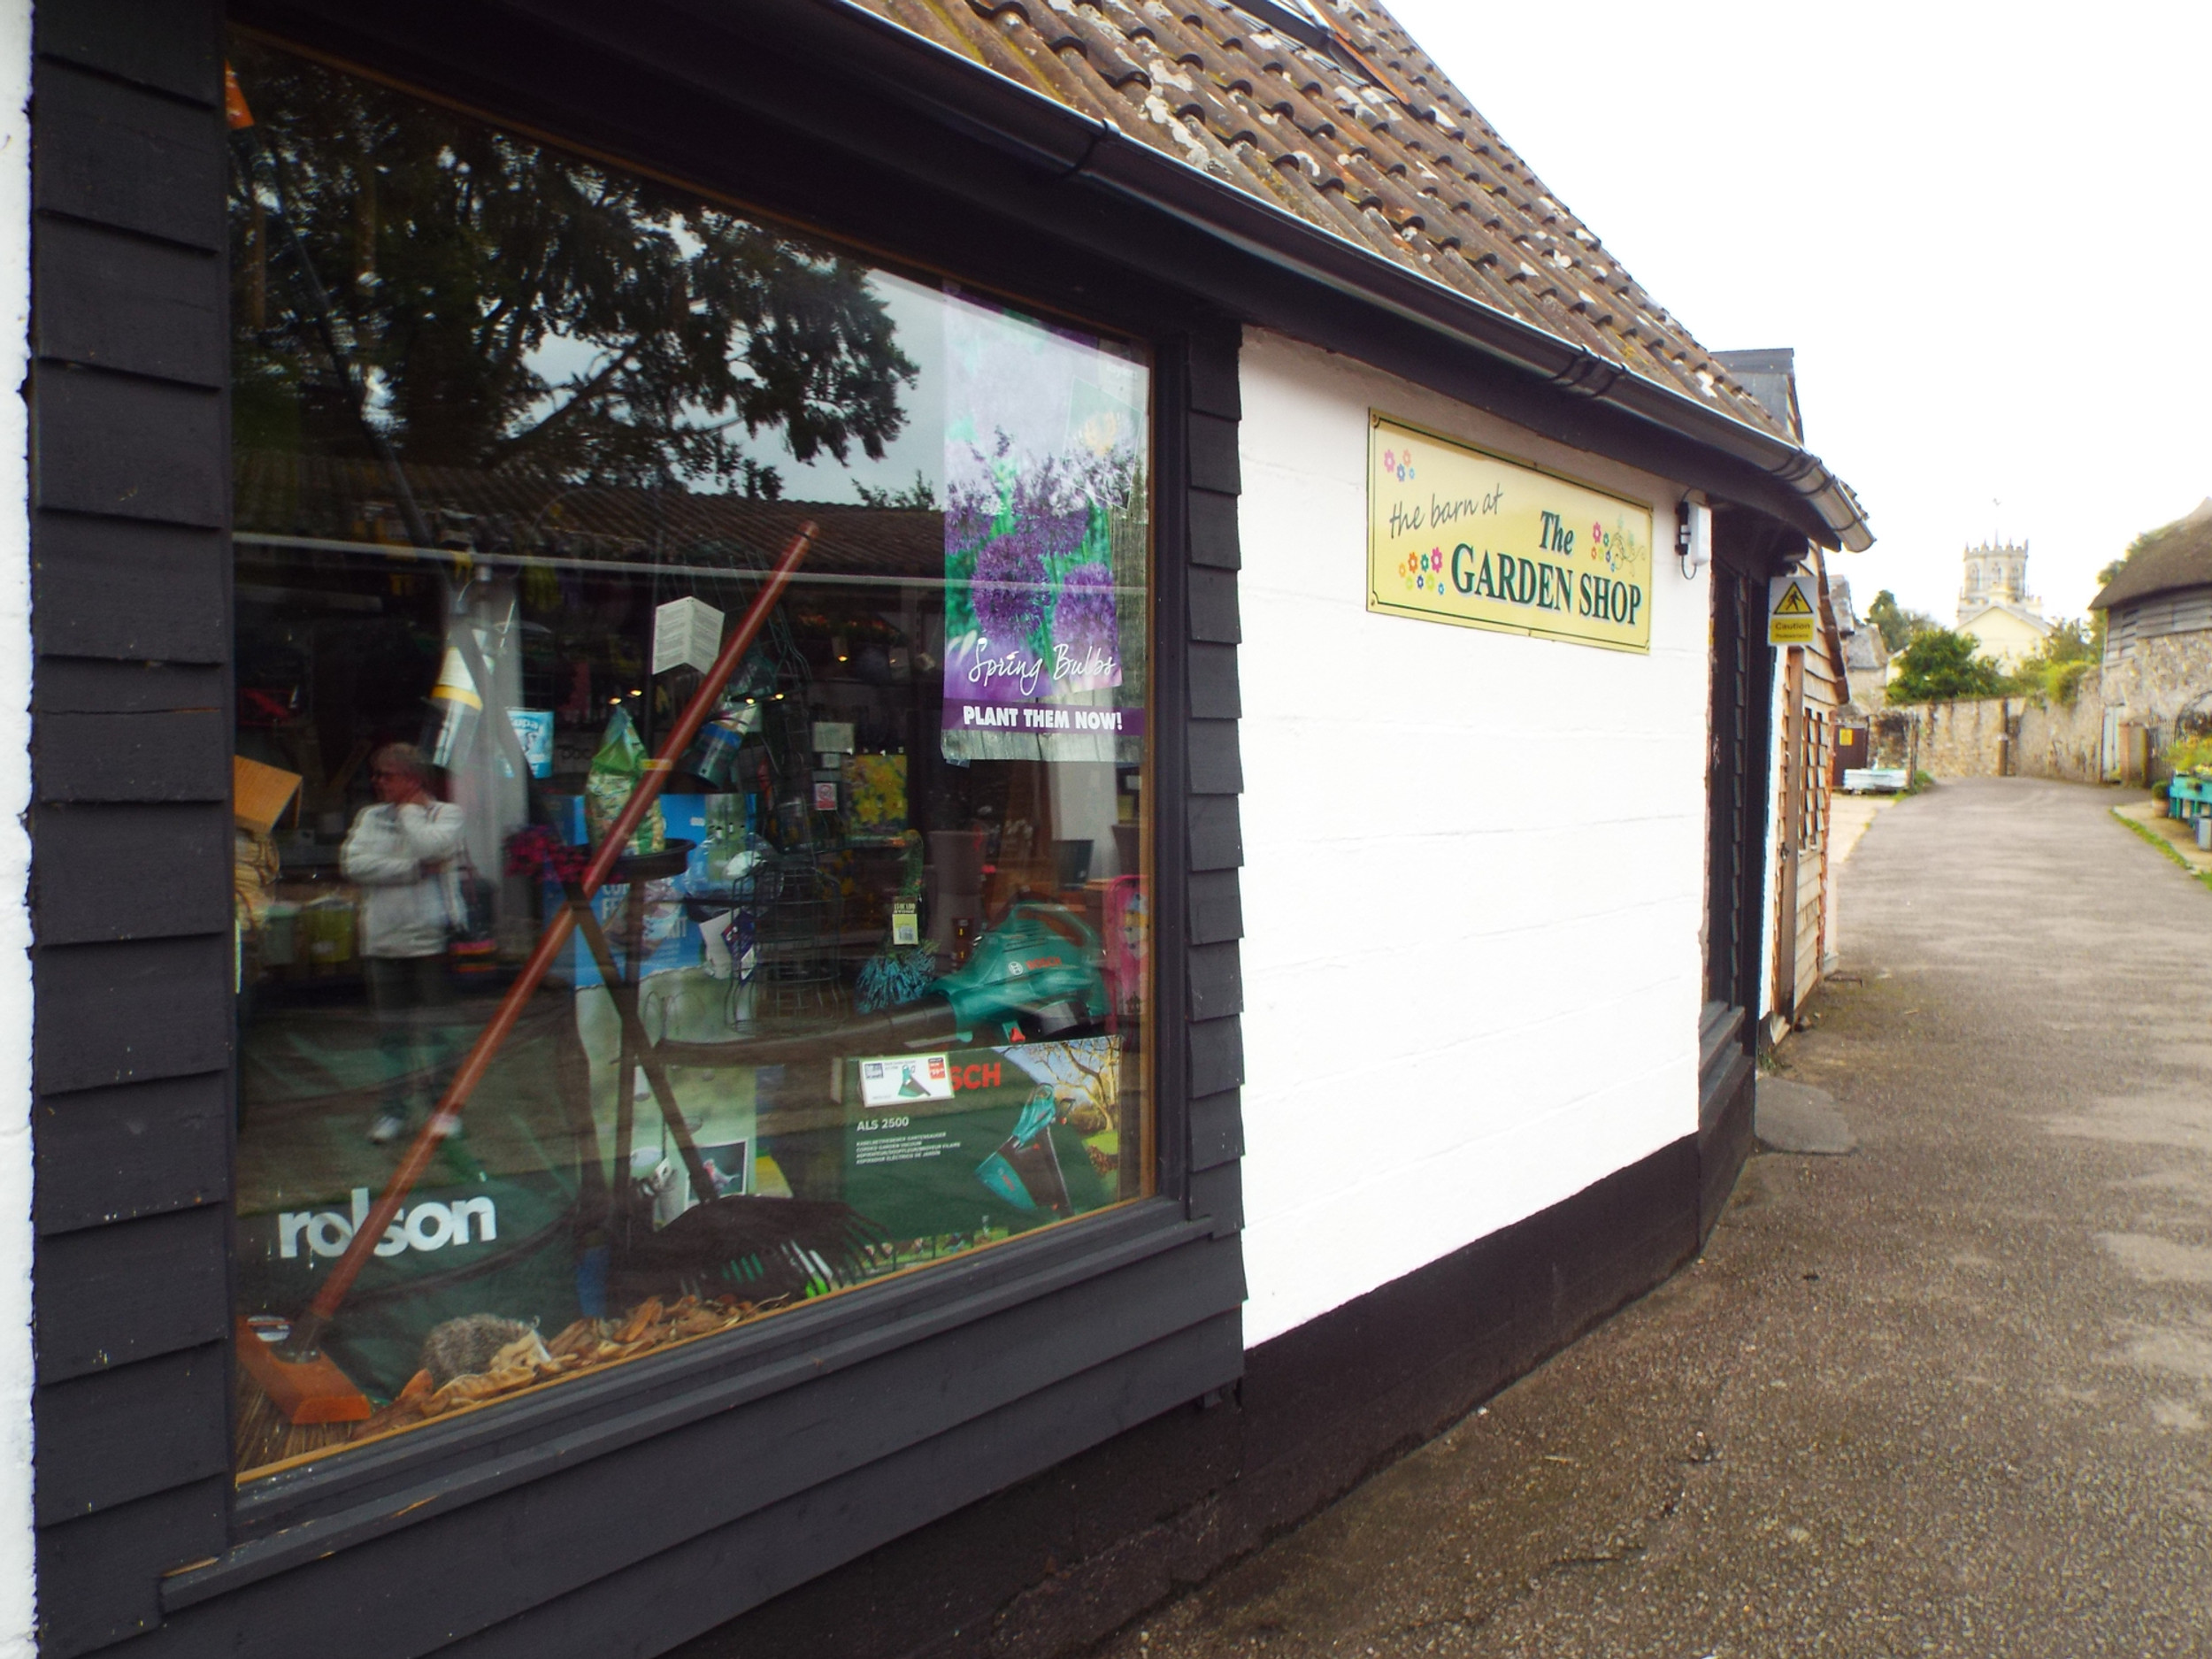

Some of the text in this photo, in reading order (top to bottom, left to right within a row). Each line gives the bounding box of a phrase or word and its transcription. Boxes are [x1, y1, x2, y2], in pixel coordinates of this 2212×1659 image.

[1389, 483, 1504, 539] the barn at
[1539, 511, 1575, 556] The
[1450, 543, 1642, 626] GARDEN SHOP
[1775, 622, 1811, 631] Caution
[968, 637, 1116, 695] Spring Bulbs
[963, 706, 1124, 731] PLANT THEM NOW!
[949, 1063, 1001, 1091] SCH
[856, 1117, 910, 1132] ALS 2500
[279, 1187, 497, 1257] rolson
